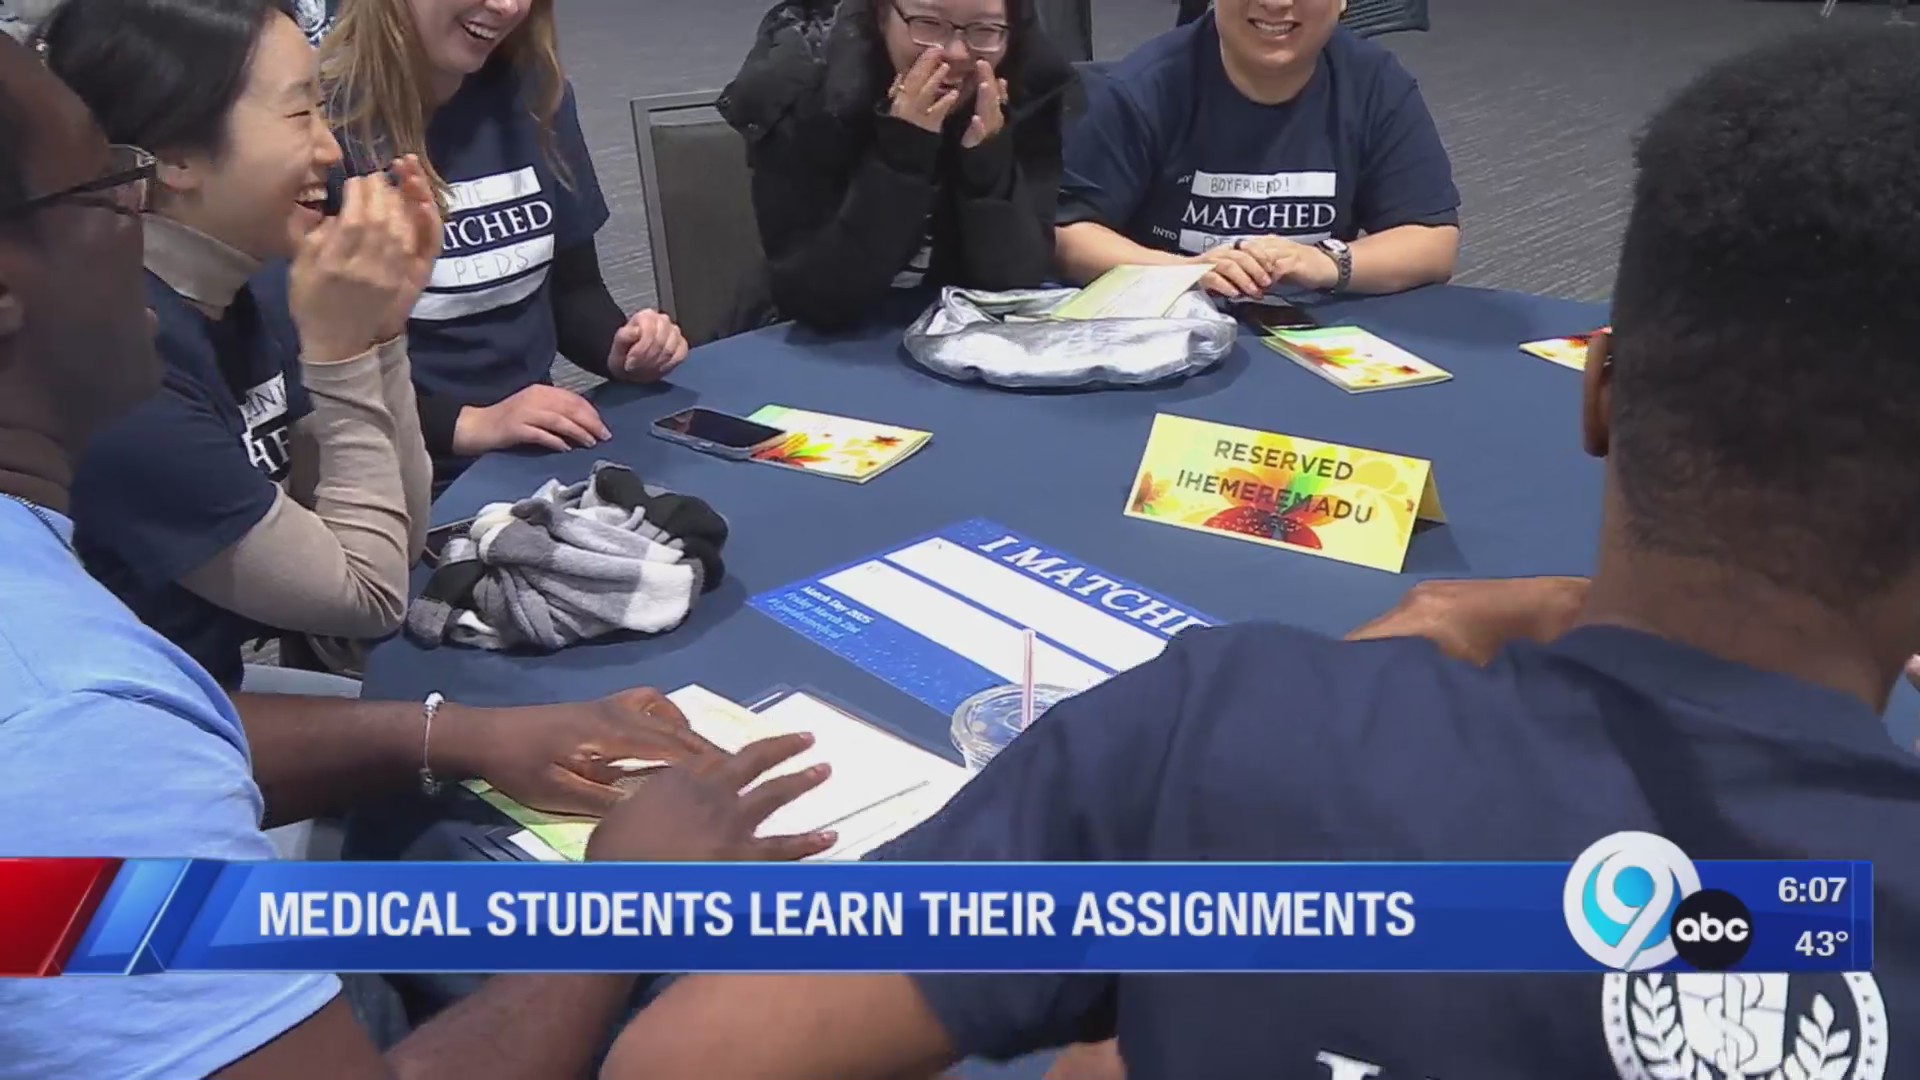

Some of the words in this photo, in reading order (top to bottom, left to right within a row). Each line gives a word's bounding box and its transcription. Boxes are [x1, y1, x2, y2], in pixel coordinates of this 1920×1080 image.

[443, 200, 553, 250] TCHED
[1152, 225, 1178, 241] INTO
[1181, 200, 1337, 229] MATCHED
[454, 244, 530, 283] PEDS
[1213, 439, 1354, 481] RESERVED
[1176, 469, 1374, 525] IHEMEREMADU
[977, 535, 1019, 553] I
[801, 585, 832, 604] Match
[828, 599, 851, 613] Day
[847, 609, 874, 625] 2025
